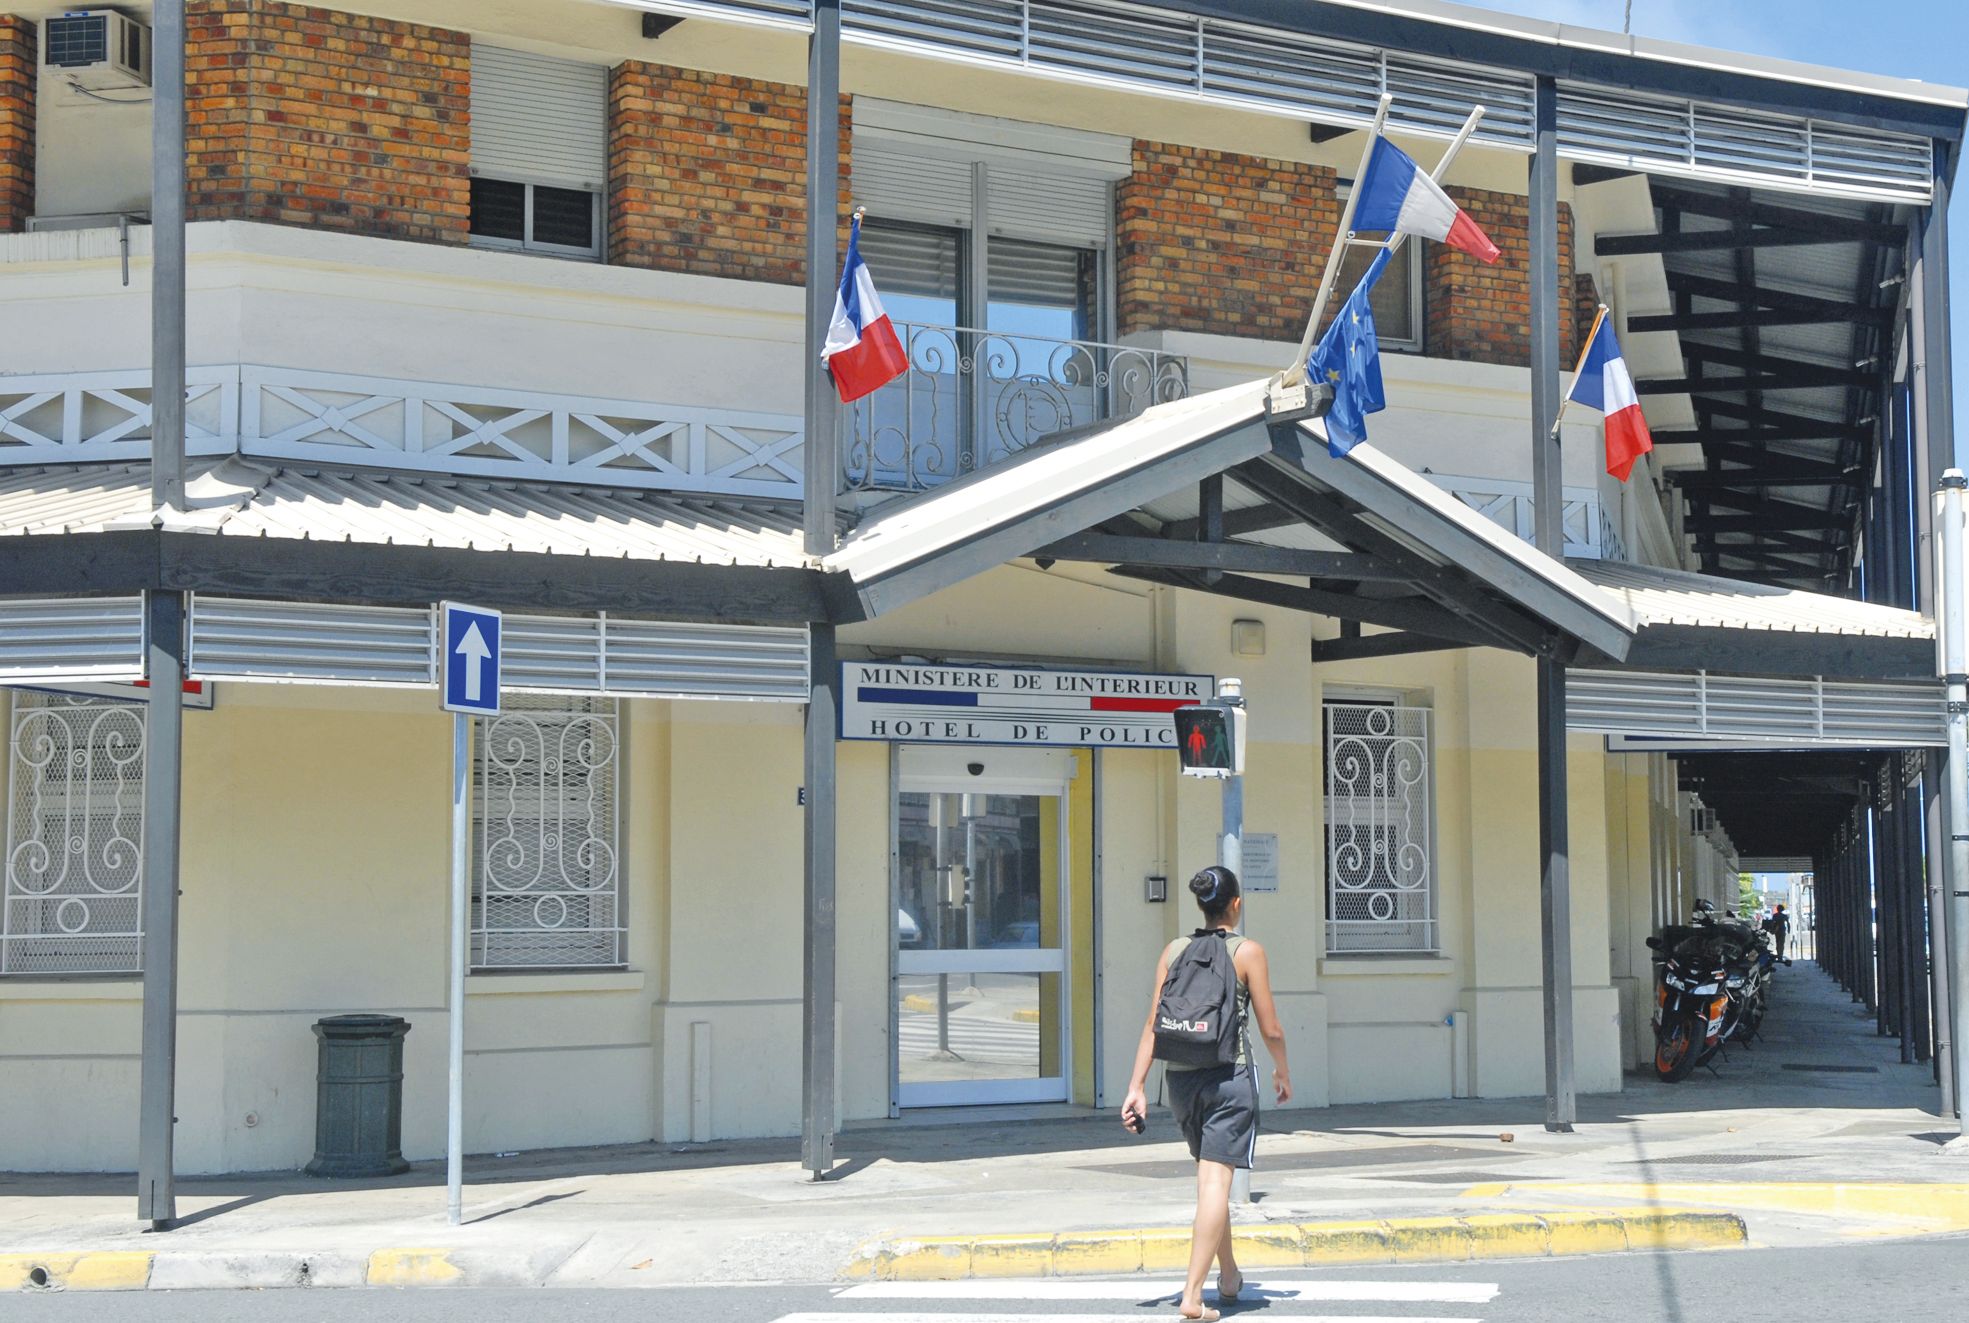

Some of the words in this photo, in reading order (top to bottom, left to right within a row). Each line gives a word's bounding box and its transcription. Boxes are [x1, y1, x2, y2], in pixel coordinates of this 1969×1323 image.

[860, 668, 999, 688] MINISTERE
[1013, 674, 1041, 690] DE
[1056, 676, 1198, 696] L'INTERIEUR
[870, 720, 981, 739] HOTEL
[1013, 725, 1049, 740] DE
[1080, 727, 1173, 743] POLIC
